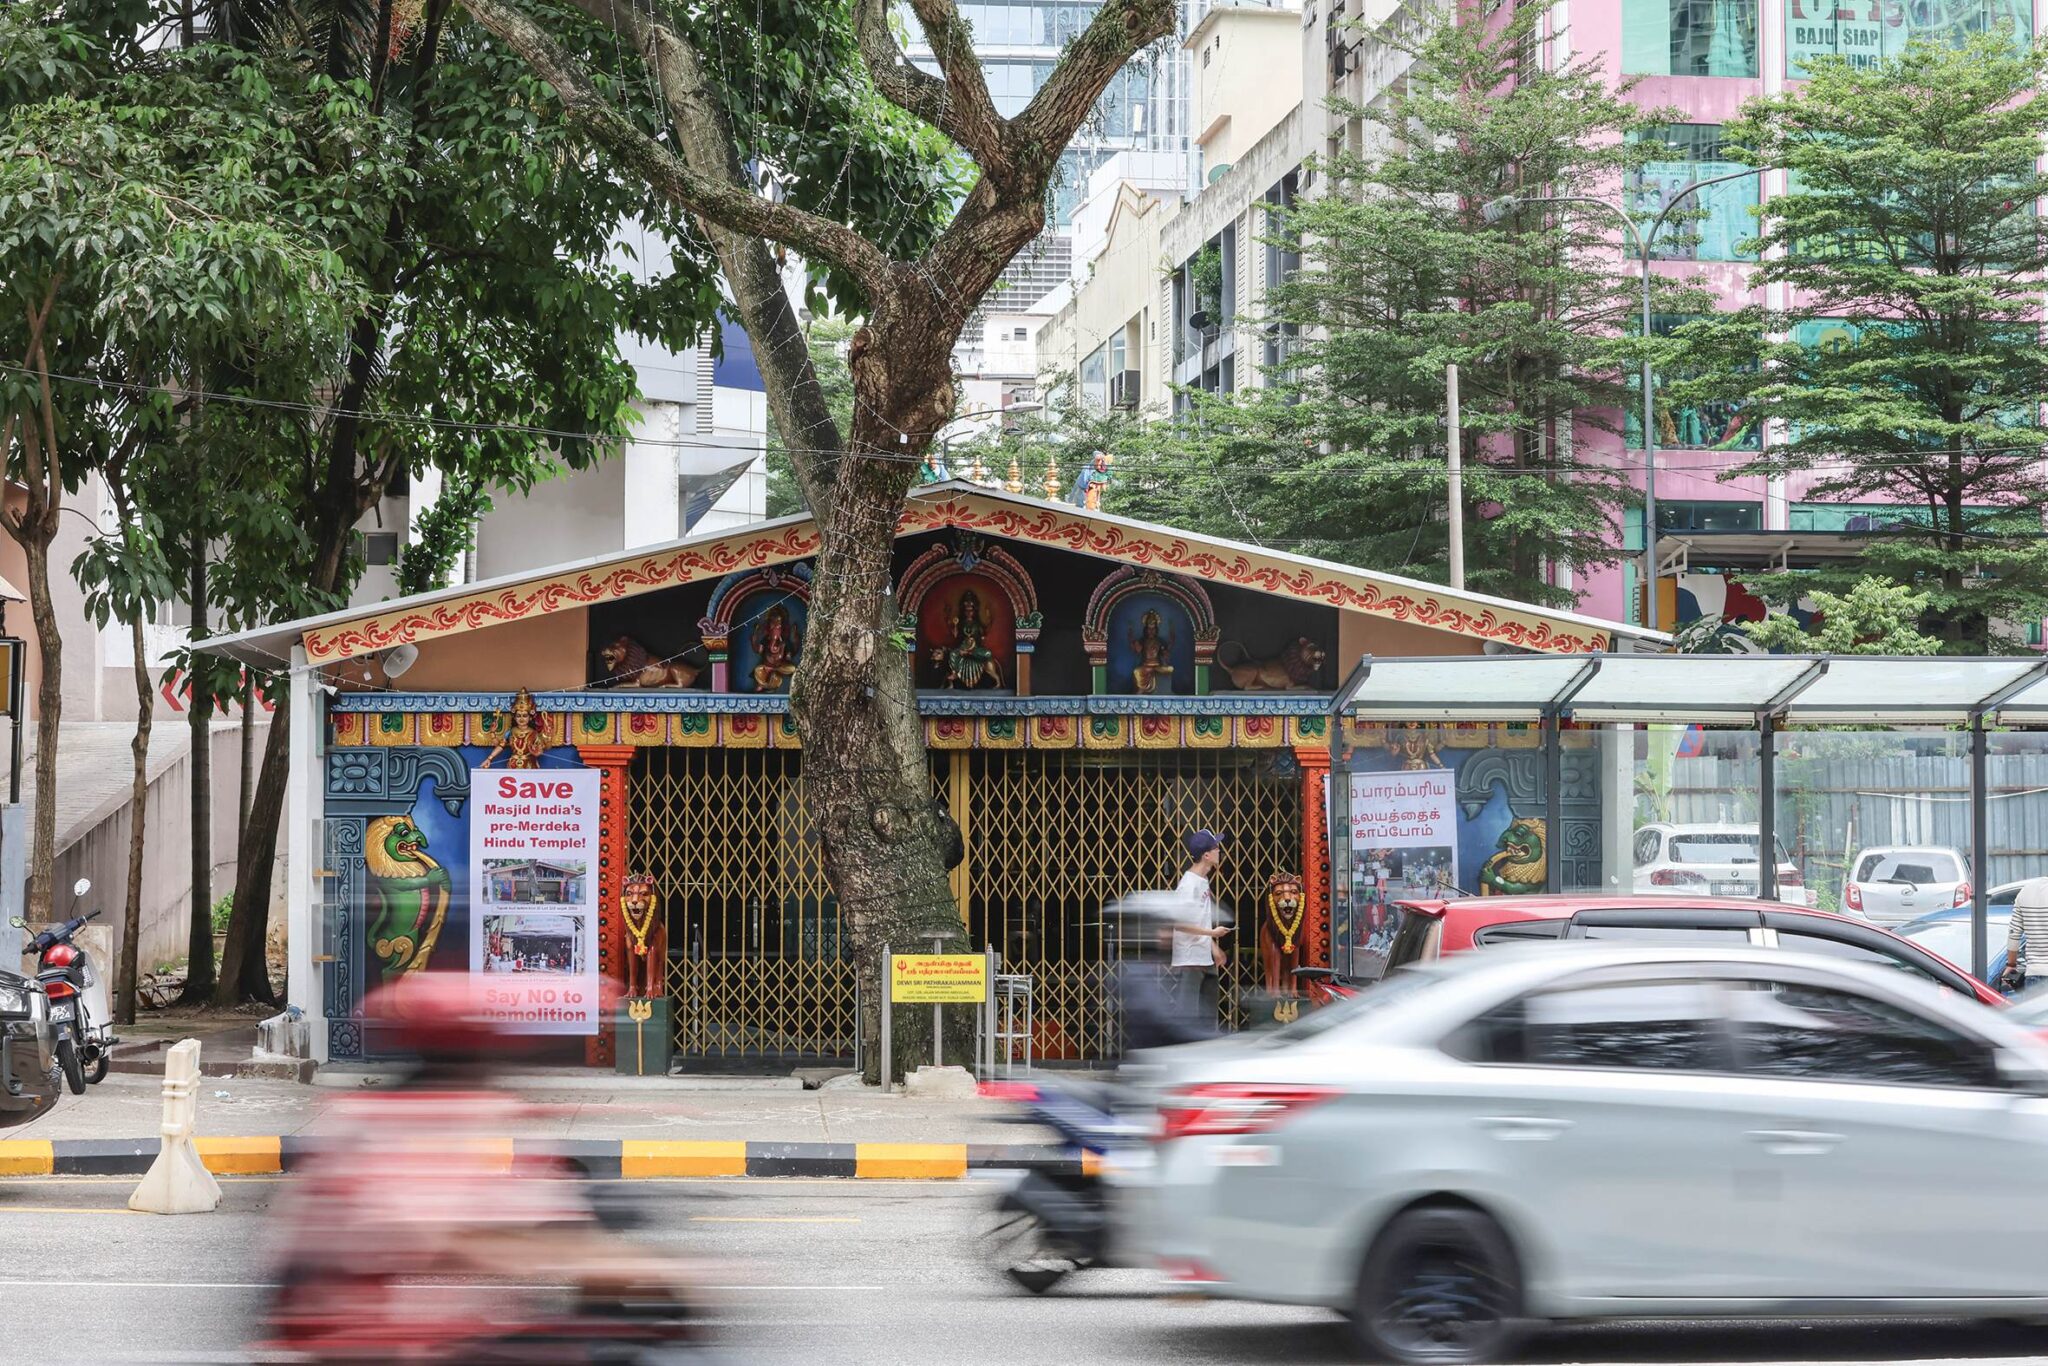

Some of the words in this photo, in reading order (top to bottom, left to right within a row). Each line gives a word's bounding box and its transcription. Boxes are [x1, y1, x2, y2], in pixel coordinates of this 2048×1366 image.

[1796, 27, 1834, 45] BAJU
[1843, 28, 1879, 46] SIAP
[498, 776, 574, 799] Save
[1362, 781, 1446, 799] பாரம்பரிய
[484, 804, 531, 817] Masjid
[535, 804, 582, 816] India’s
[490, 821, 580, 834] pre-Merdeka
[1355, 824, 1434, 838] காப்போம்
[484, 837, 525, 849] Hindu
[529, 837, 586, 850] Temple!
[486, 989, 521, 1006] Say
[528, 989, 557, 1004] NO
[563, 990, 583, 1004] to
